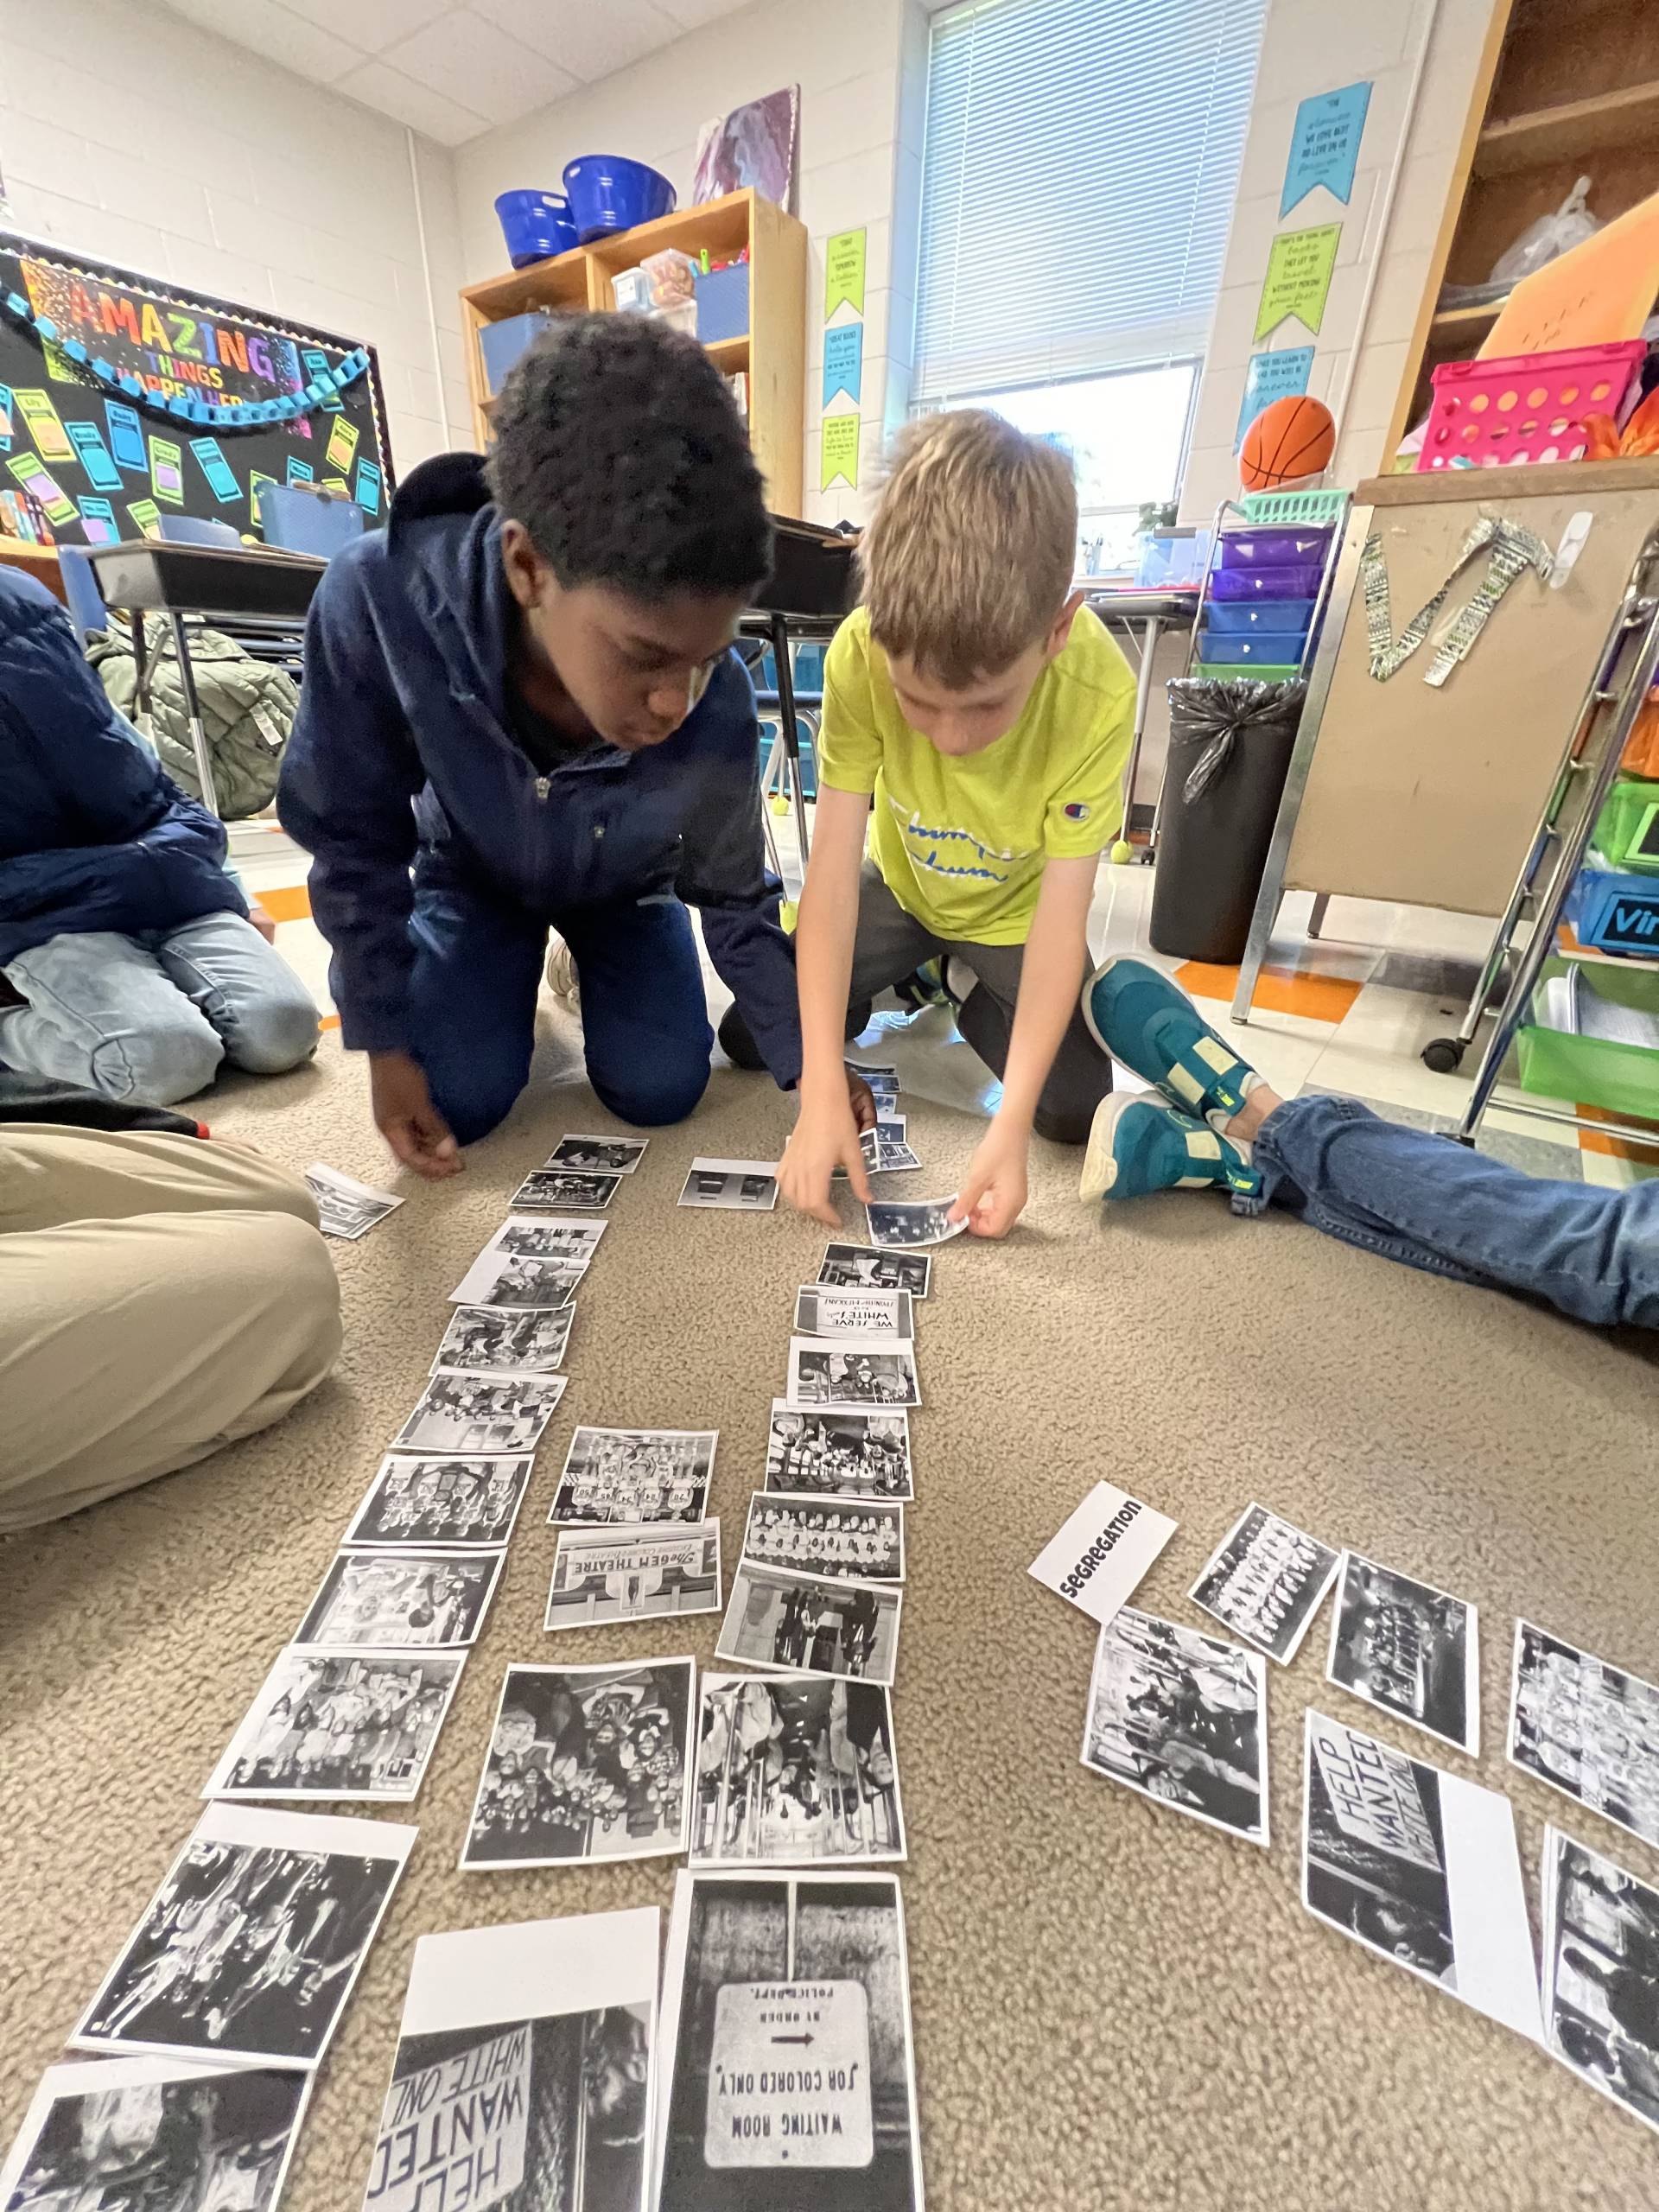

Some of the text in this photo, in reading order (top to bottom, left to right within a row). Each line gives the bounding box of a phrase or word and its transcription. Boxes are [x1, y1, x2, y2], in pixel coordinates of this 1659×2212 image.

[71, 282, 276, 383] AMAZING
[144, 351, 223, 389] THINGS
[575, 1557, 632, 1573] THEATRE
[639, 1555, 670, 1567] GEM
[1319, 1735, 1370, 1825] HELP
[759, 2011, 821, 2024] BY ORDER
[381, 2028, 527, 2131] WHITE ONL
[760, 2070, 822, 2094] COLORED
[731, 2113, 842, 2138] WAITING ROOM
